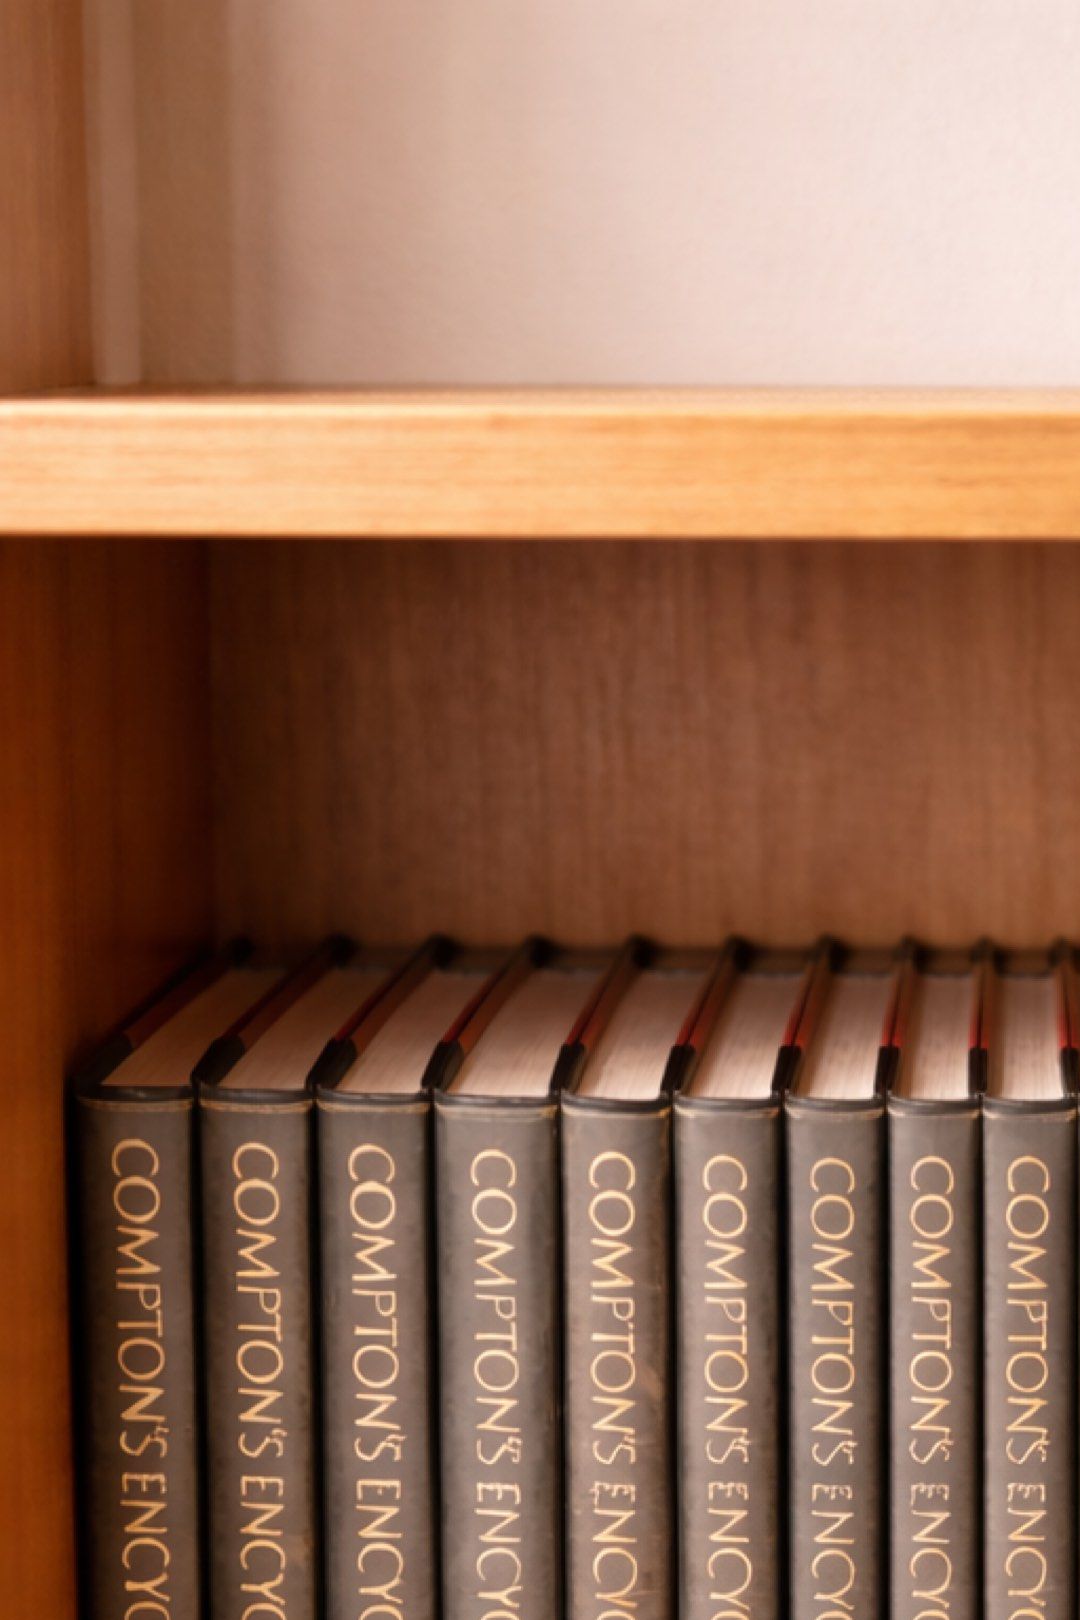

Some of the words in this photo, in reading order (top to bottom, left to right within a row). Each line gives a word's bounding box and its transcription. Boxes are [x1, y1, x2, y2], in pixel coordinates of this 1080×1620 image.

[112, 1139, 169, 1457] COMPTON'S
[231, 1142, 287, 1457] COMPTON'S
[348, 1144, 407, 1461] COMPTON'S
[470, 1149, 522, 1465] COMPTON'S
[588, 1151, 637, 1465] COMPTON'S
[701, 1154, 751, 1464] COMPTON'S
[808, 1157, 857, 1466] COMPTON'S
